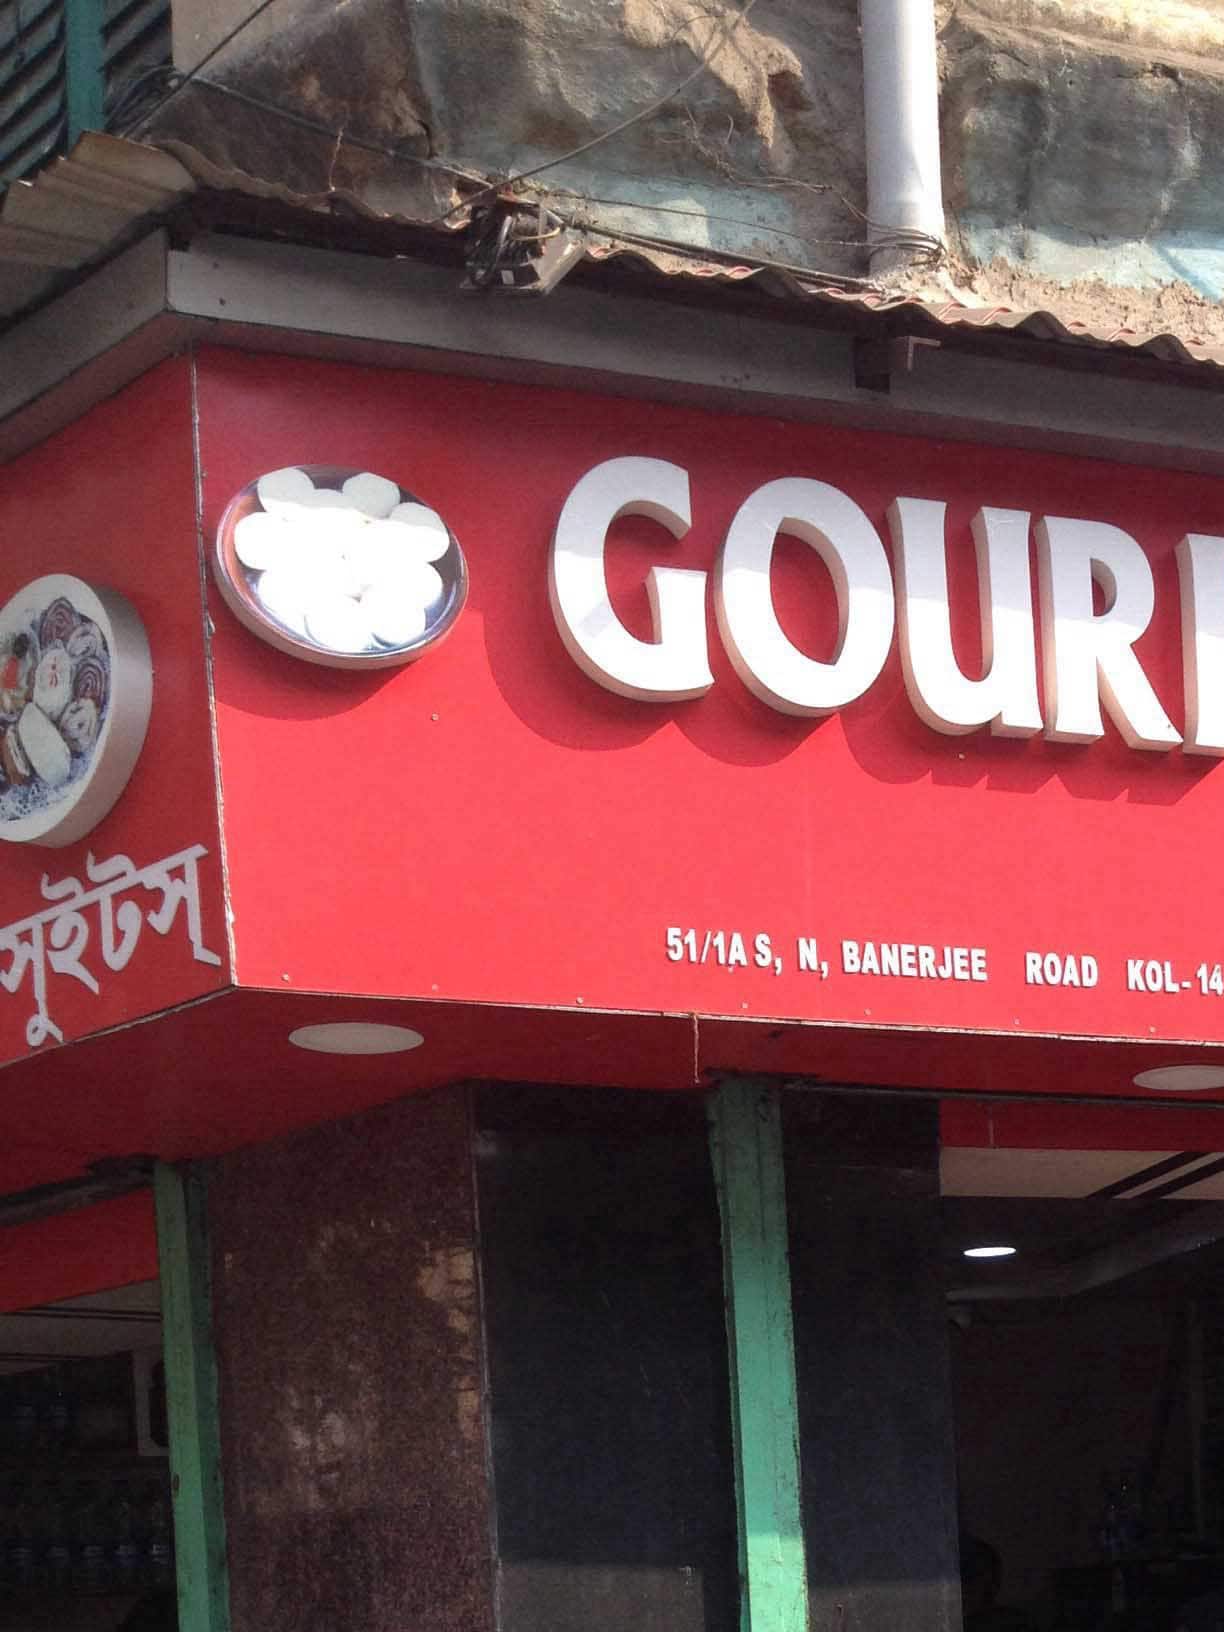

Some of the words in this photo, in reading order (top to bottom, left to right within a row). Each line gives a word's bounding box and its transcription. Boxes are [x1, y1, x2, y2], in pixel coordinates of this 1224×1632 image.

[797, 937, 829, 979] N,
[841, 940, 988, 982] BANERJEE
[1025, 951, 1099, 988] ROAD
